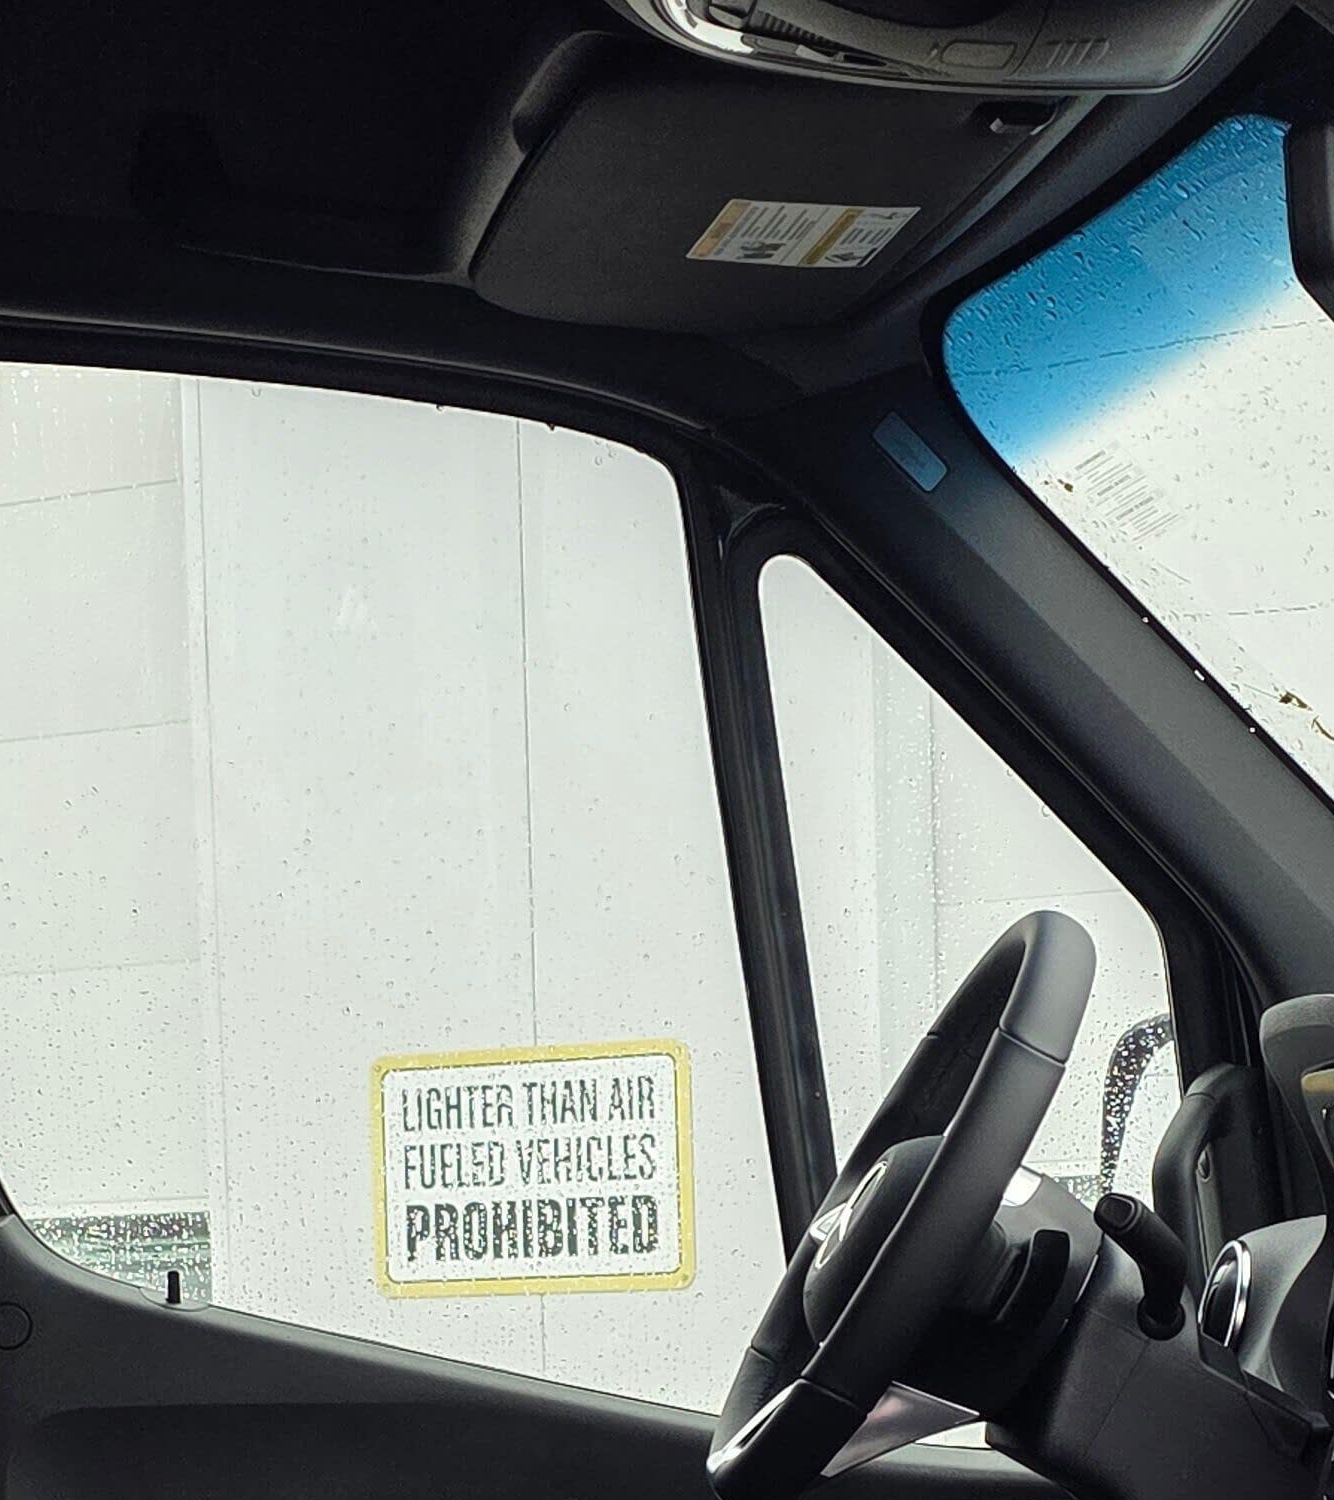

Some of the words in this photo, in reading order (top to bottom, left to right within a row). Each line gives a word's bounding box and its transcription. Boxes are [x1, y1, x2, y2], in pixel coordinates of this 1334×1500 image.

[402, 1083, 514, 1132] LIGHTER
[522, 1078, 598, 1126] THAN
[608, 1075, 656, 1121] AIR
[403, 1141, 505, 1190] FUELED
[516, 1133, 657, 1185] VEHICLES
[405, 1195, 659, 1262] PROHIBITED
